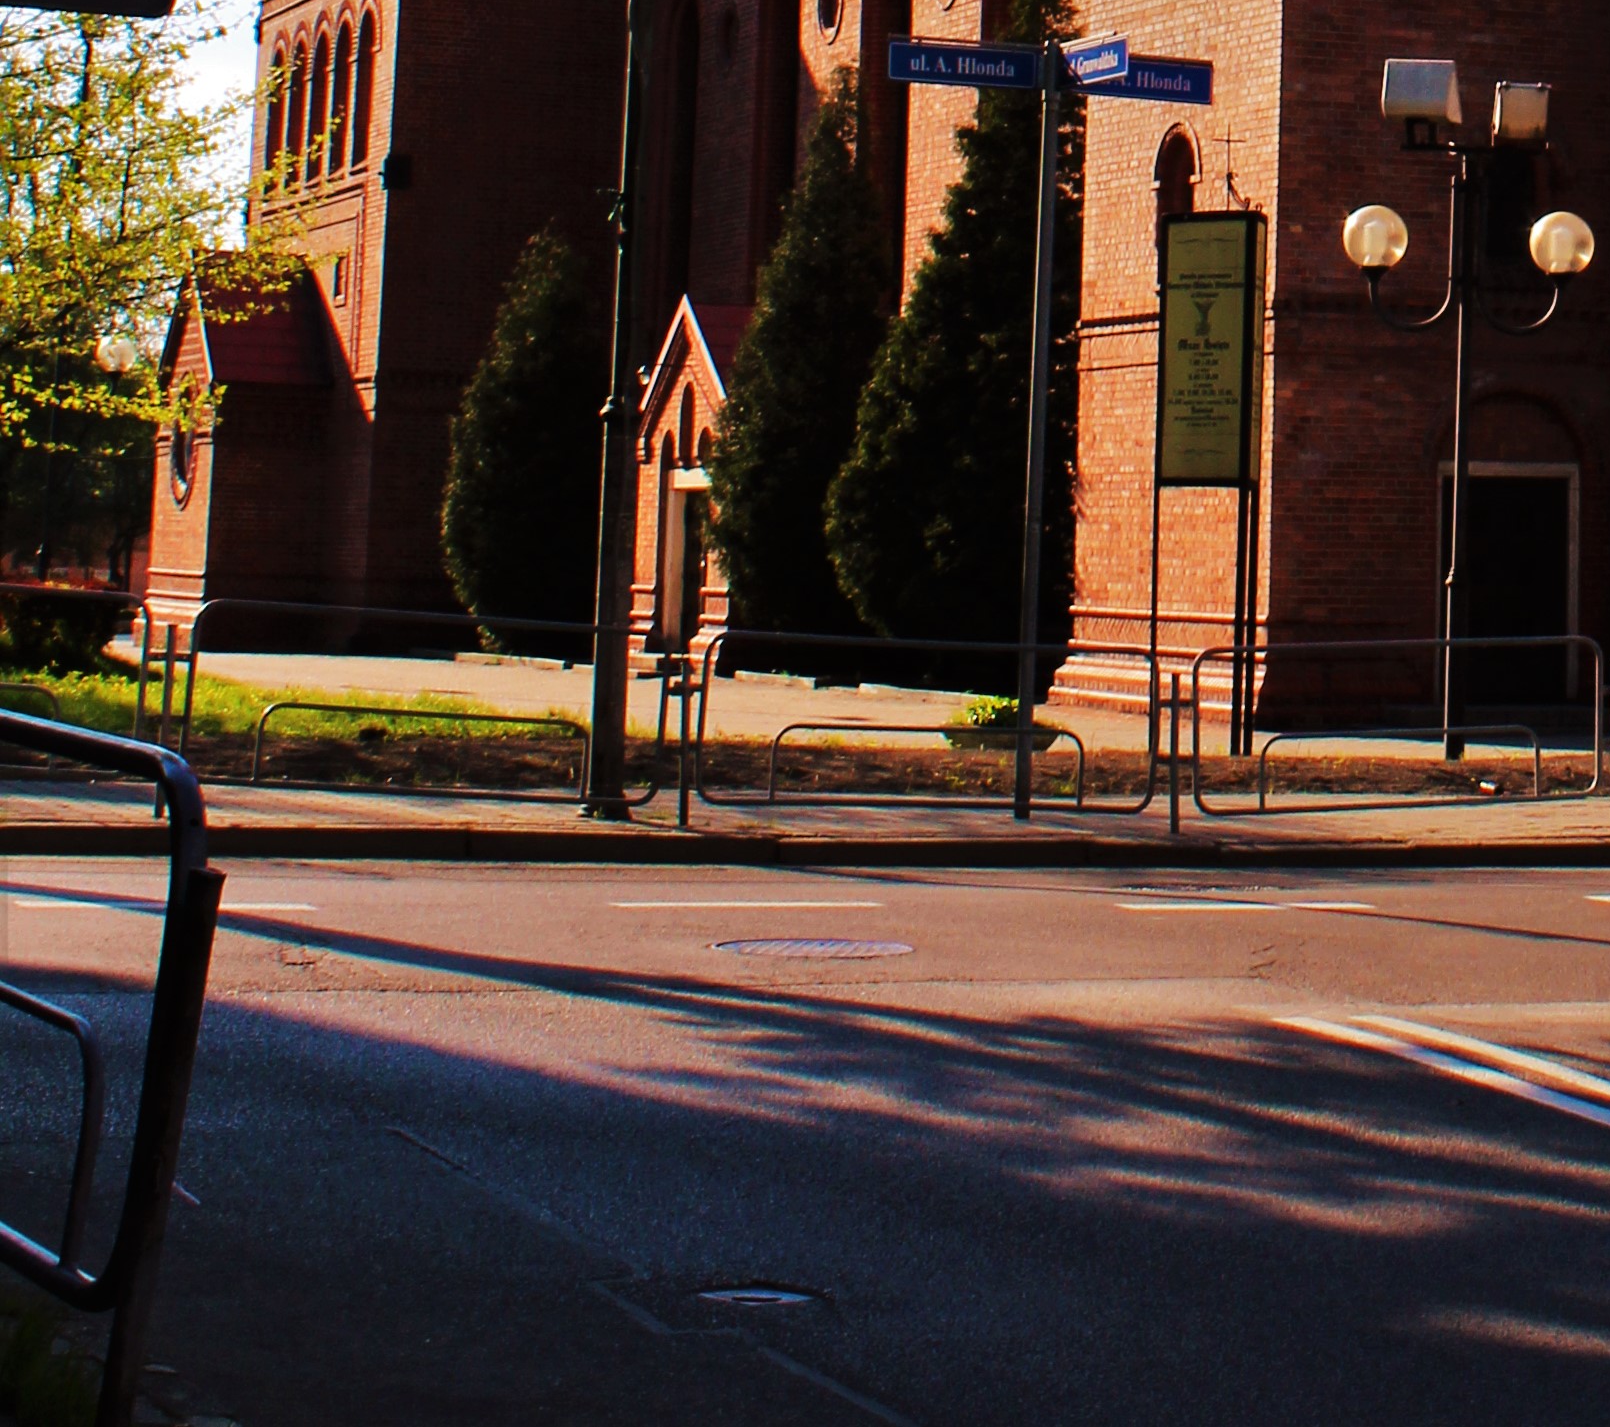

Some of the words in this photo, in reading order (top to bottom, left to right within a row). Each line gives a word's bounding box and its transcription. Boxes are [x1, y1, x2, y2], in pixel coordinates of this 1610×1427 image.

[910, 54, 931, 72] ul.
[934, 56, 952, 73] A.
[957, 57, 1015, 77] Hlonda
[1136, 70, 1191, 92] Hlonda
